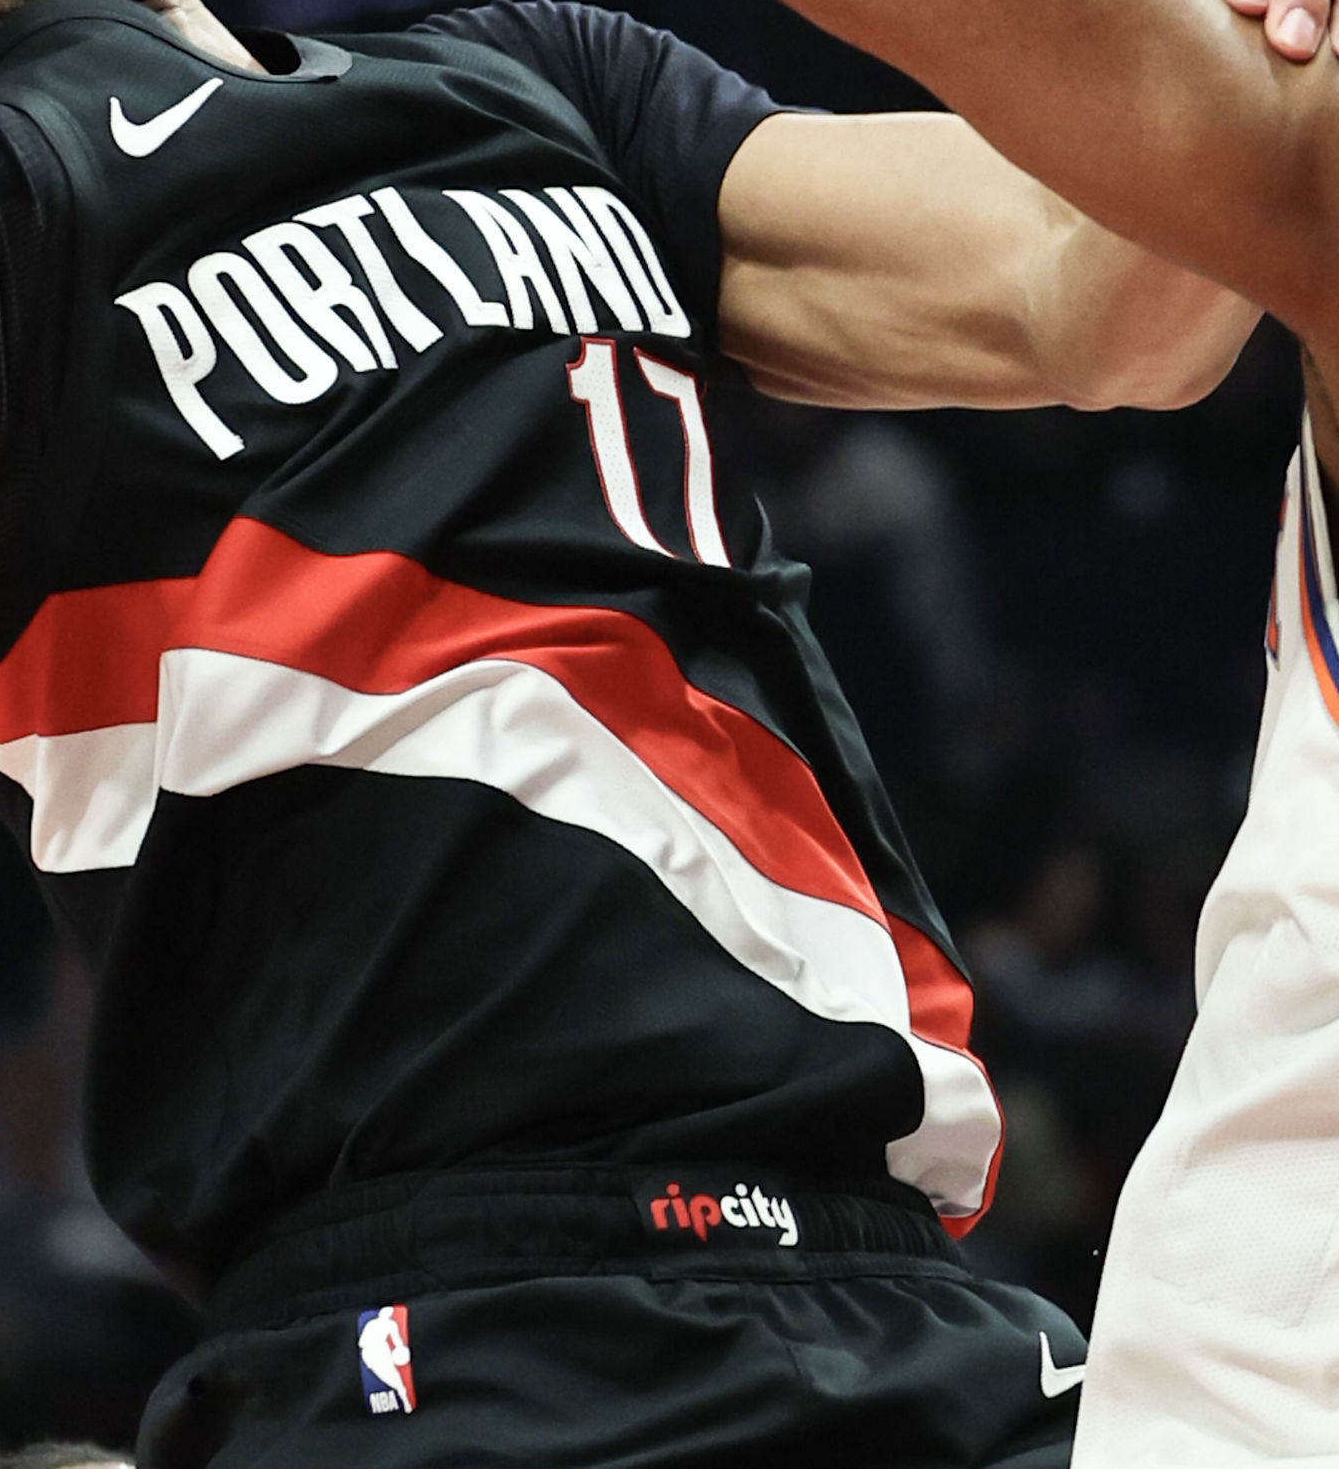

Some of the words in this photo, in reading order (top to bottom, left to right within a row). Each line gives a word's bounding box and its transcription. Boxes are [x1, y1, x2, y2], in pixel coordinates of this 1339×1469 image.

[114, 186, 691, 461] PORTLAND
[566, 335, 731, 568] 17
[369, 1390, 400, 1414] NBA
